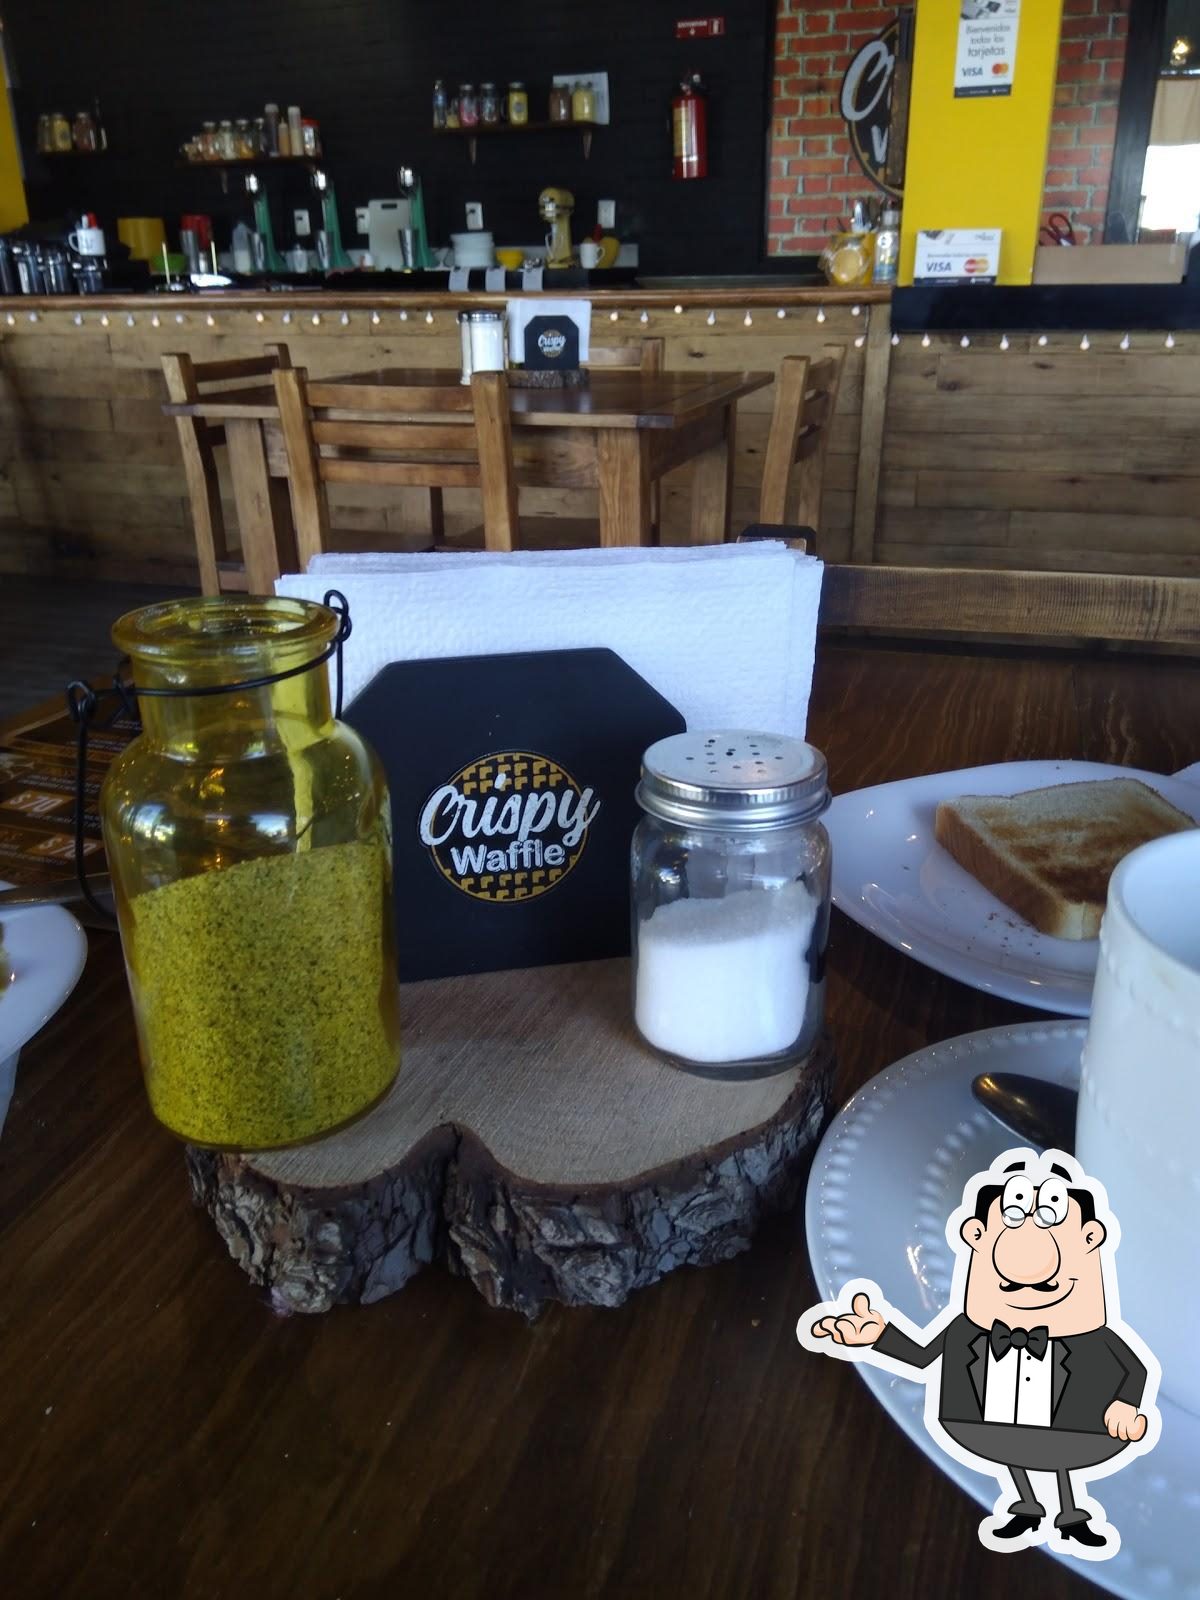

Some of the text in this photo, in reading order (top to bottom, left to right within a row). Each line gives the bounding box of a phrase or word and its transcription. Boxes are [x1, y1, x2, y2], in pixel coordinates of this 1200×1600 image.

[968, 46, 1005, 60] tarjetas
[962, 67, 983, 77] VISA
[927, 262, 952, 272] VISA
[538, 333, 566, 347] Crispy
[419, 773, 601, 848] Crispy
[450, 838, 566, 876] Waffle
